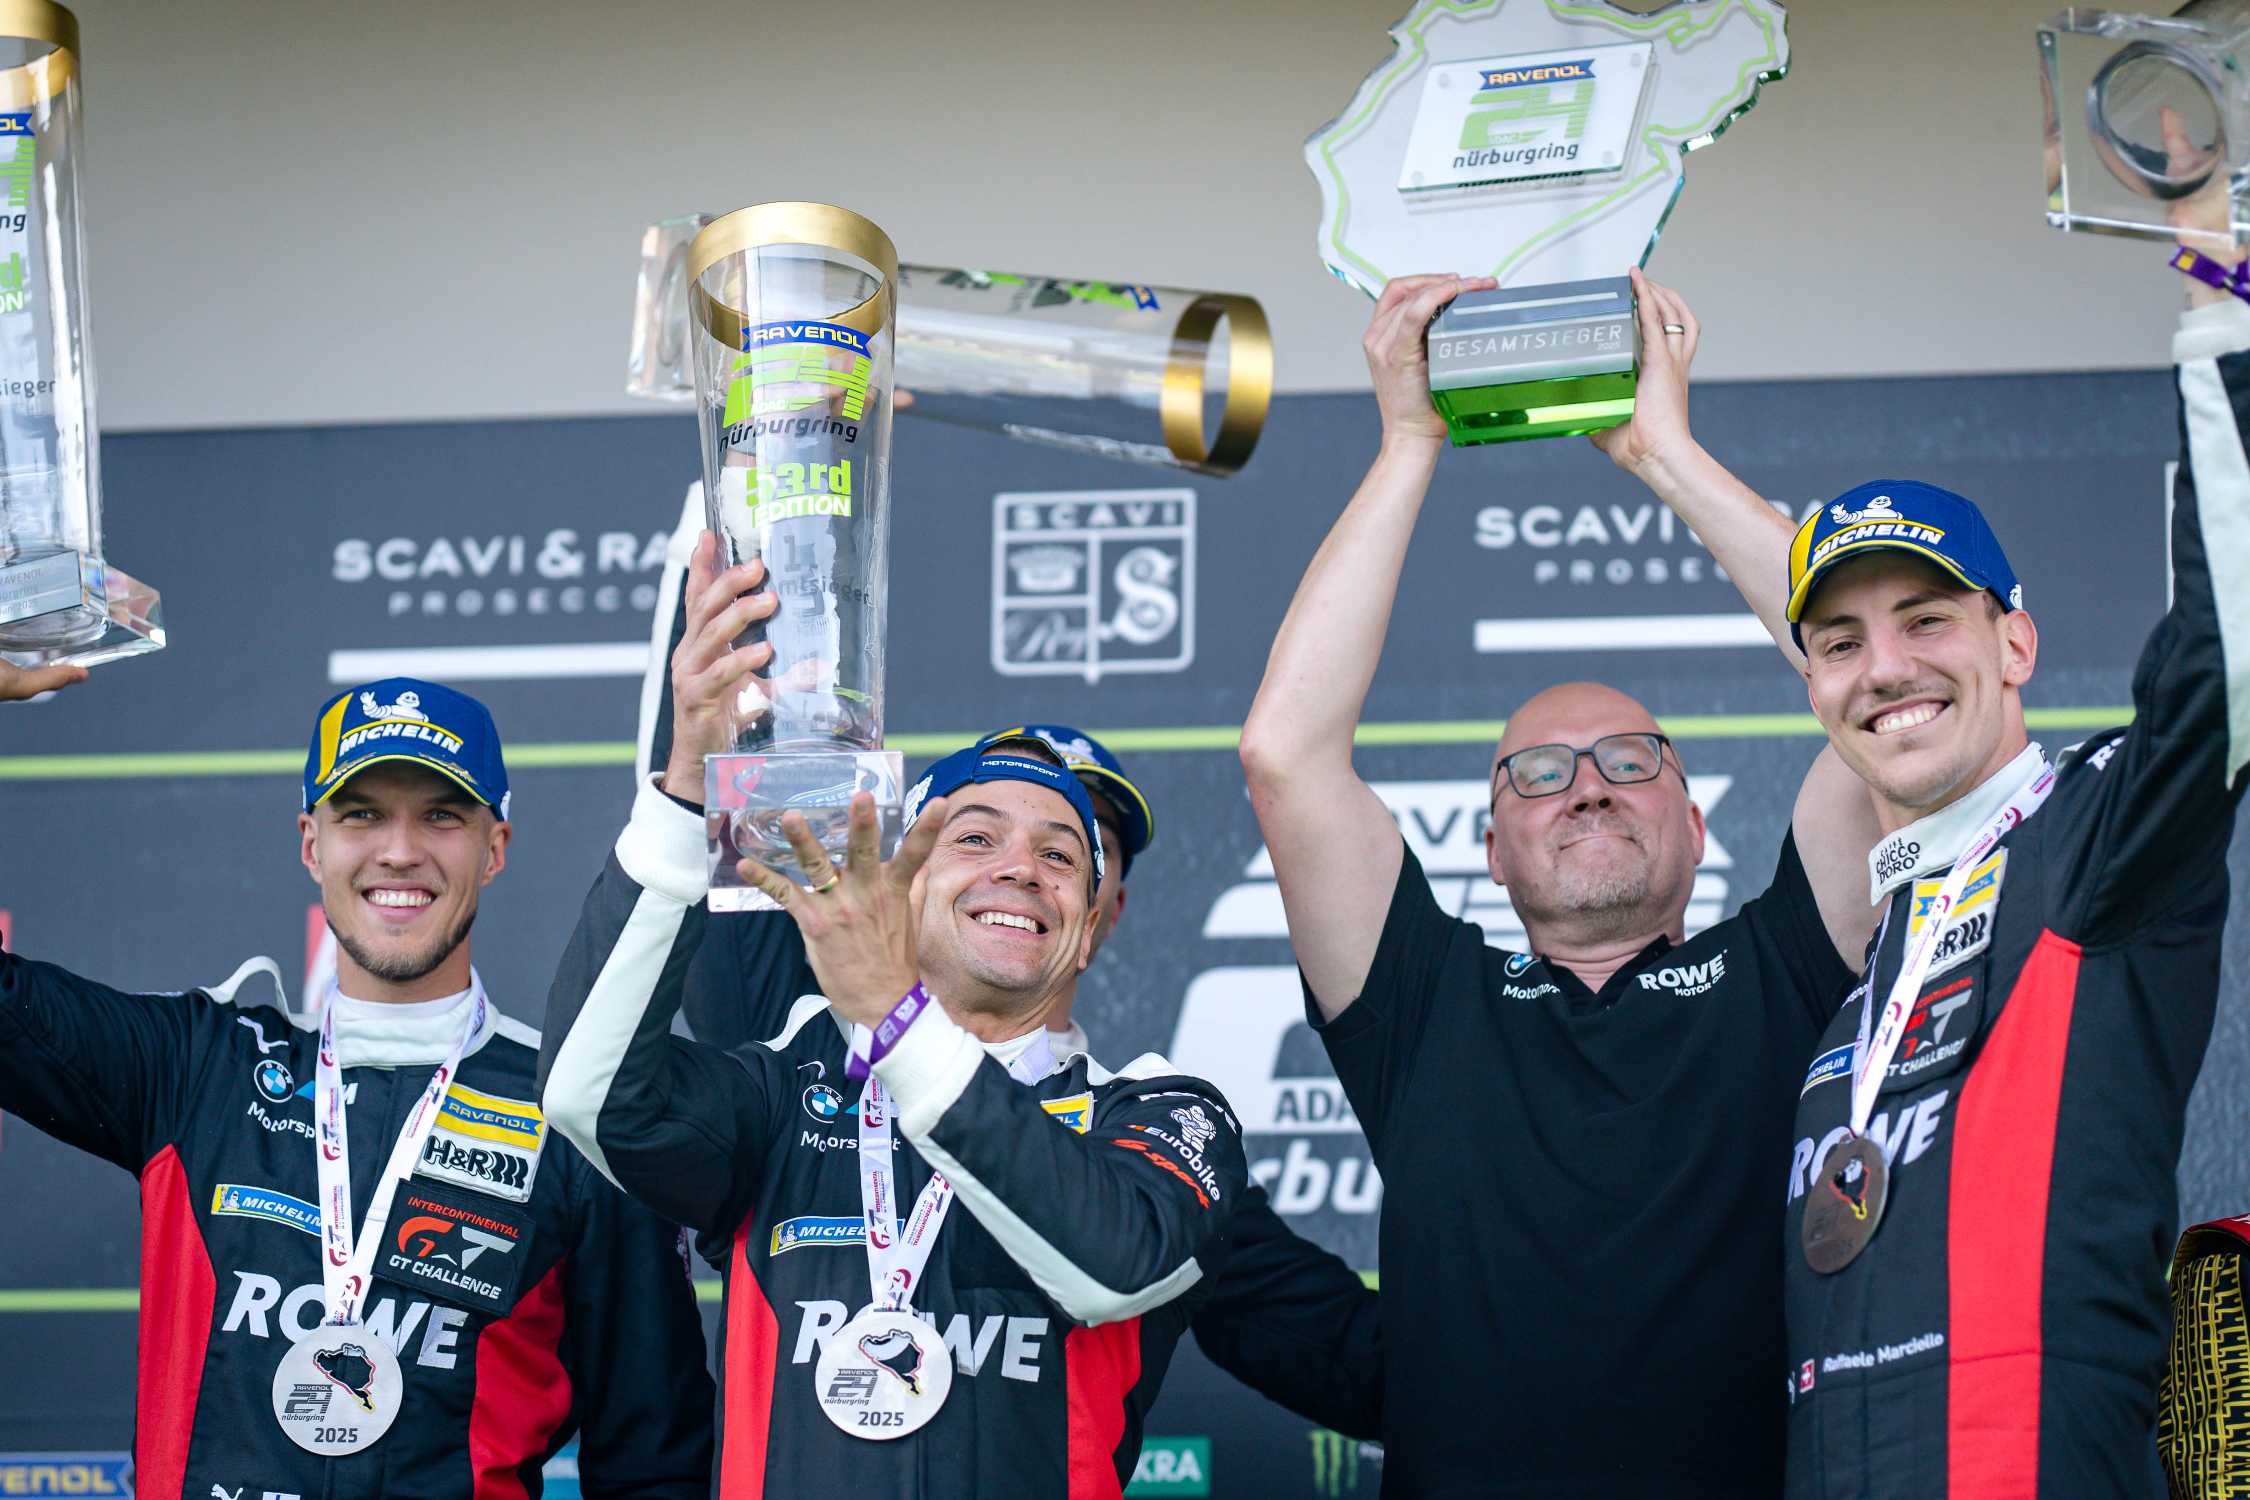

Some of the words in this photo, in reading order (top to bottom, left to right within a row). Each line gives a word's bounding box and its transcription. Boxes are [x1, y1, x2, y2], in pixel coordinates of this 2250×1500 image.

[1488, 65, 1585, 85] RAVENOL
[1453, 143, 1579, 168] nürburgring
[752, 325, 865, 350] RAVENOL
[1438, 324, 1623, 359] GESAMTSIEGER
[719, 415, 859, 452] nürburgring
[746, 459, 851, 507] 53rd
[754, 495, 852, 527] EDITION
[1014, 501, 1178, 530] SCAVI
[1474, 503, 1674, 549] SCAVI
[332, 535, 526, 582] SCAVI
[536, 528, 585, 578] &
[596, 531, 671, 574] RA
[1811, 523, 1942, 563] MICHELIN
[388, 584, 658, 617] PROSECCO
[338, 723, 464, 758] MICHELIN
[982, 759, 1061, 780] MOTORSPORT
[1876, 842, 1920, 874] CHICCO
[1635, 953, 1725, 990] ROWE
[1674, 982, 1712, 997] MOTOR
[247, 1101, 315, 1139] Motorsp
[449, 1102, 530, 1131] RAVENOL
[425, 1134, 492, 1180] H&R
[1144, 1126, 1221, 1201] Eurobike
[407, 1196, 521, 1239] INTERCONTINENTAL
[800, 1226, 867, 1237] MICHEL
[389, 1254, 412, 1270] GT
[411, 1260, 502, 1300] CHALLENGE
[792, 1300, 1049, 1383] RWE
[1822, 1350, 1875, 1373] Raffaele
[1876, 1332, 1944, 1364] Marciello
[281, 1413, 325, 1422] nürburgring
[824, 1398, 870, 1406] nürburgring
[858, 1410, 905, 1426] 2025
[314, 1427, 358, 1443] 2025
